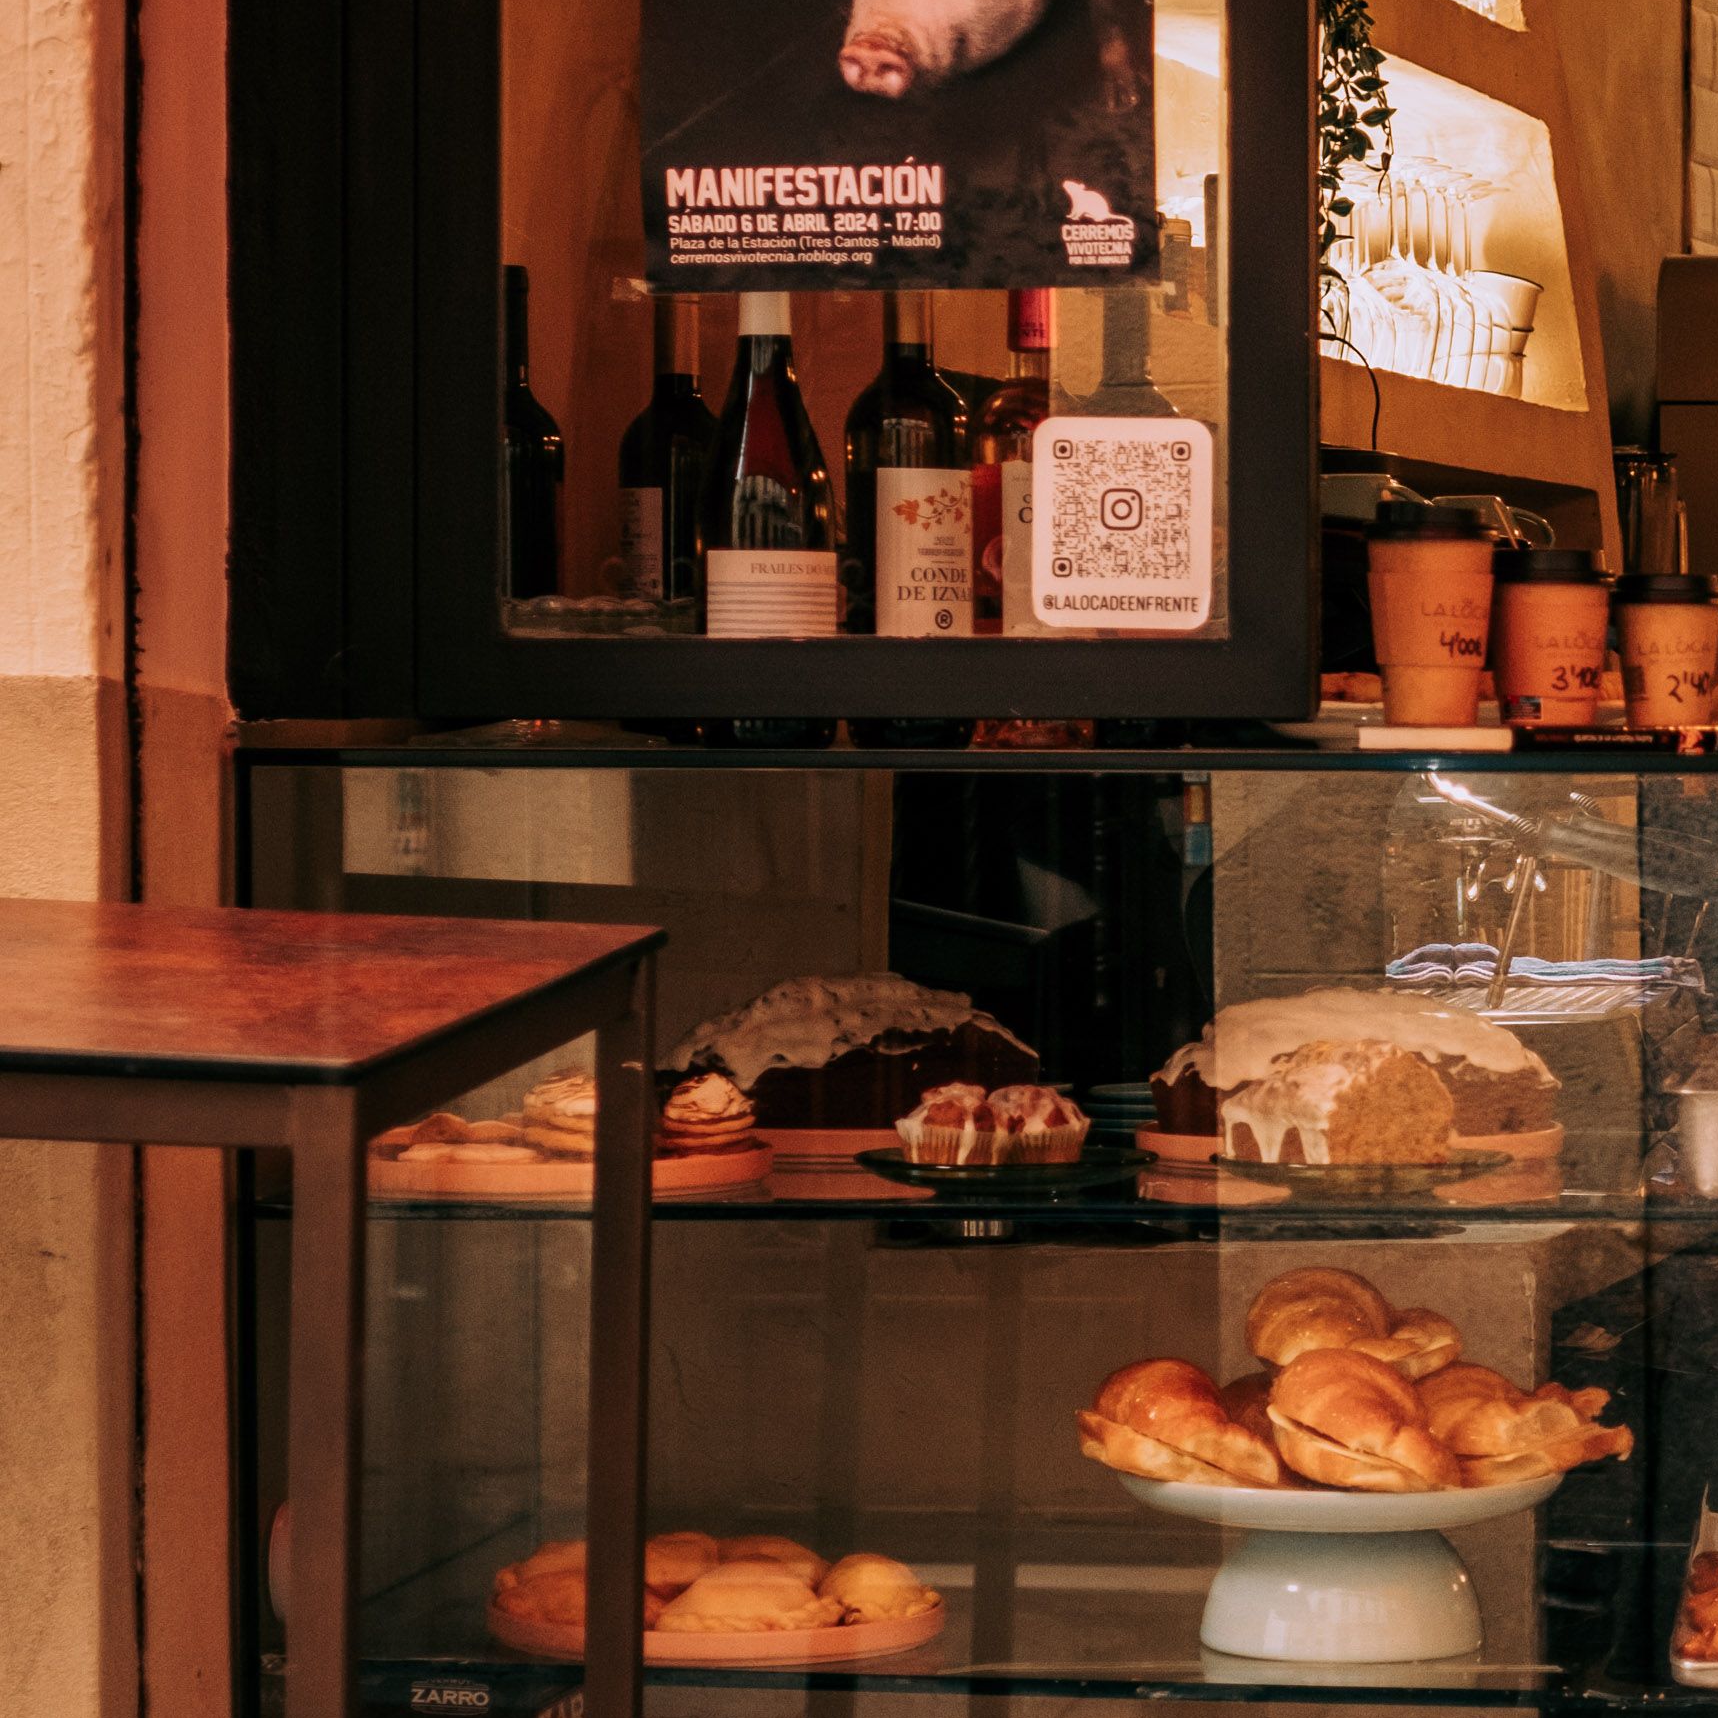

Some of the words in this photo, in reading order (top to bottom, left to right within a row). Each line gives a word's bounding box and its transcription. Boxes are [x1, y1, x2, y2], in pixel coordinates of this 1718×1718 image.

[665, 156, 943, 207] MANIFESTACIÓN
[668, 208, 736, 233] SÁBADO
[740, 215, 753, 232] 6
[756, 214, 778, 232] DE
[782, 213, 830, 232] ABRIL
[834, 212, 879, 232] 2024
[896, 212, 942, 231] 17:00
[1061, 224, 1135, 241] CERREMOS
[670, 236, 706, 249] Plaza
[708, 236, 725, 249] de
[727, 236, 740, 248] la
[742, 236, 797, 248] Estación
[799, 235, 832, 249] (Tres
[834, 235, 879, 247] Cantos
[892, 235, 941, 249] Madrid)
[1065, 242, 1132, 256] VIVOTECNIA
[670, 250, 873, 264] cerremosvivotecnia.noblogs.org
[750, 563, 804, 575] FRAILES
[911, 567, 968, 583] CONDE
[897, 586, 926, 601] DE
[1043, 594, 1199, 613] @LALOCADEENFRENTE
[411, 1688, 489, 1708] ZARRO
